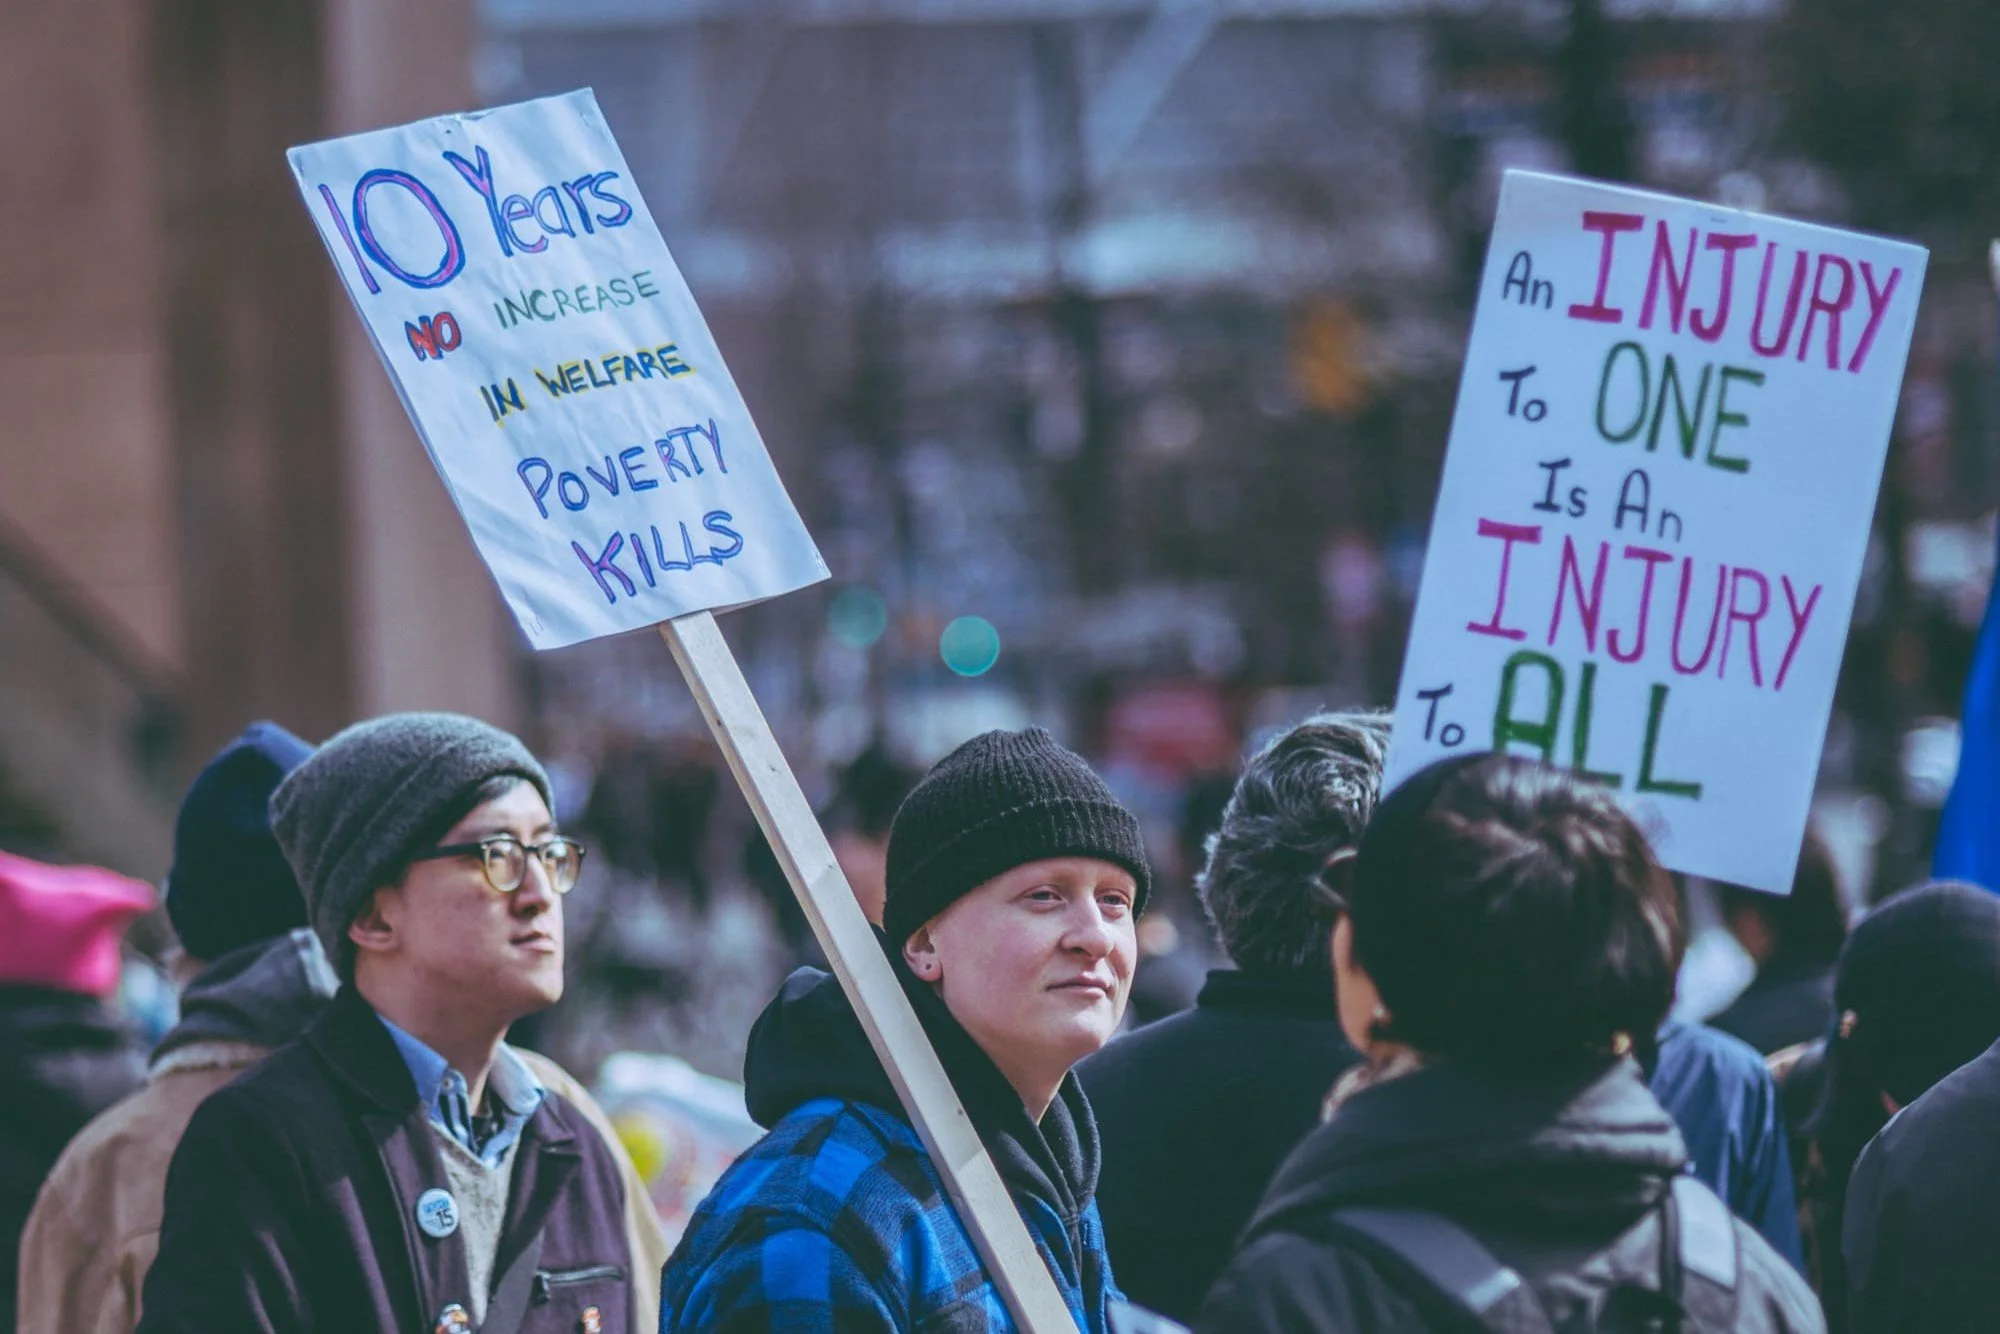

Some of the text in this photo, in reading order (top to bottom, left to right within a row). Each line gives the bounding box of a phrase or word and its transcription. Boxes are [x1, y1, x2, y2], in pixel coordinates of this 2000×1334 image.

[318, 145, 633, 295] 10 Years
[404, 271, 661, 361] NO INCREASE
[1503, 210, 1902, 373] An INJURY
[480, 343, 693, 424] IN WELFARE
[1499, 340, 1765, 474] To ONE
[516, 418, 728, 519] POVERTY
[1533, 458, 1683, 542] Is An
[571, 510, 744, 605] KILLS
[1466, 518, 1823, 691] INJURY
[1417, 649, 1702, 800] To ALL
